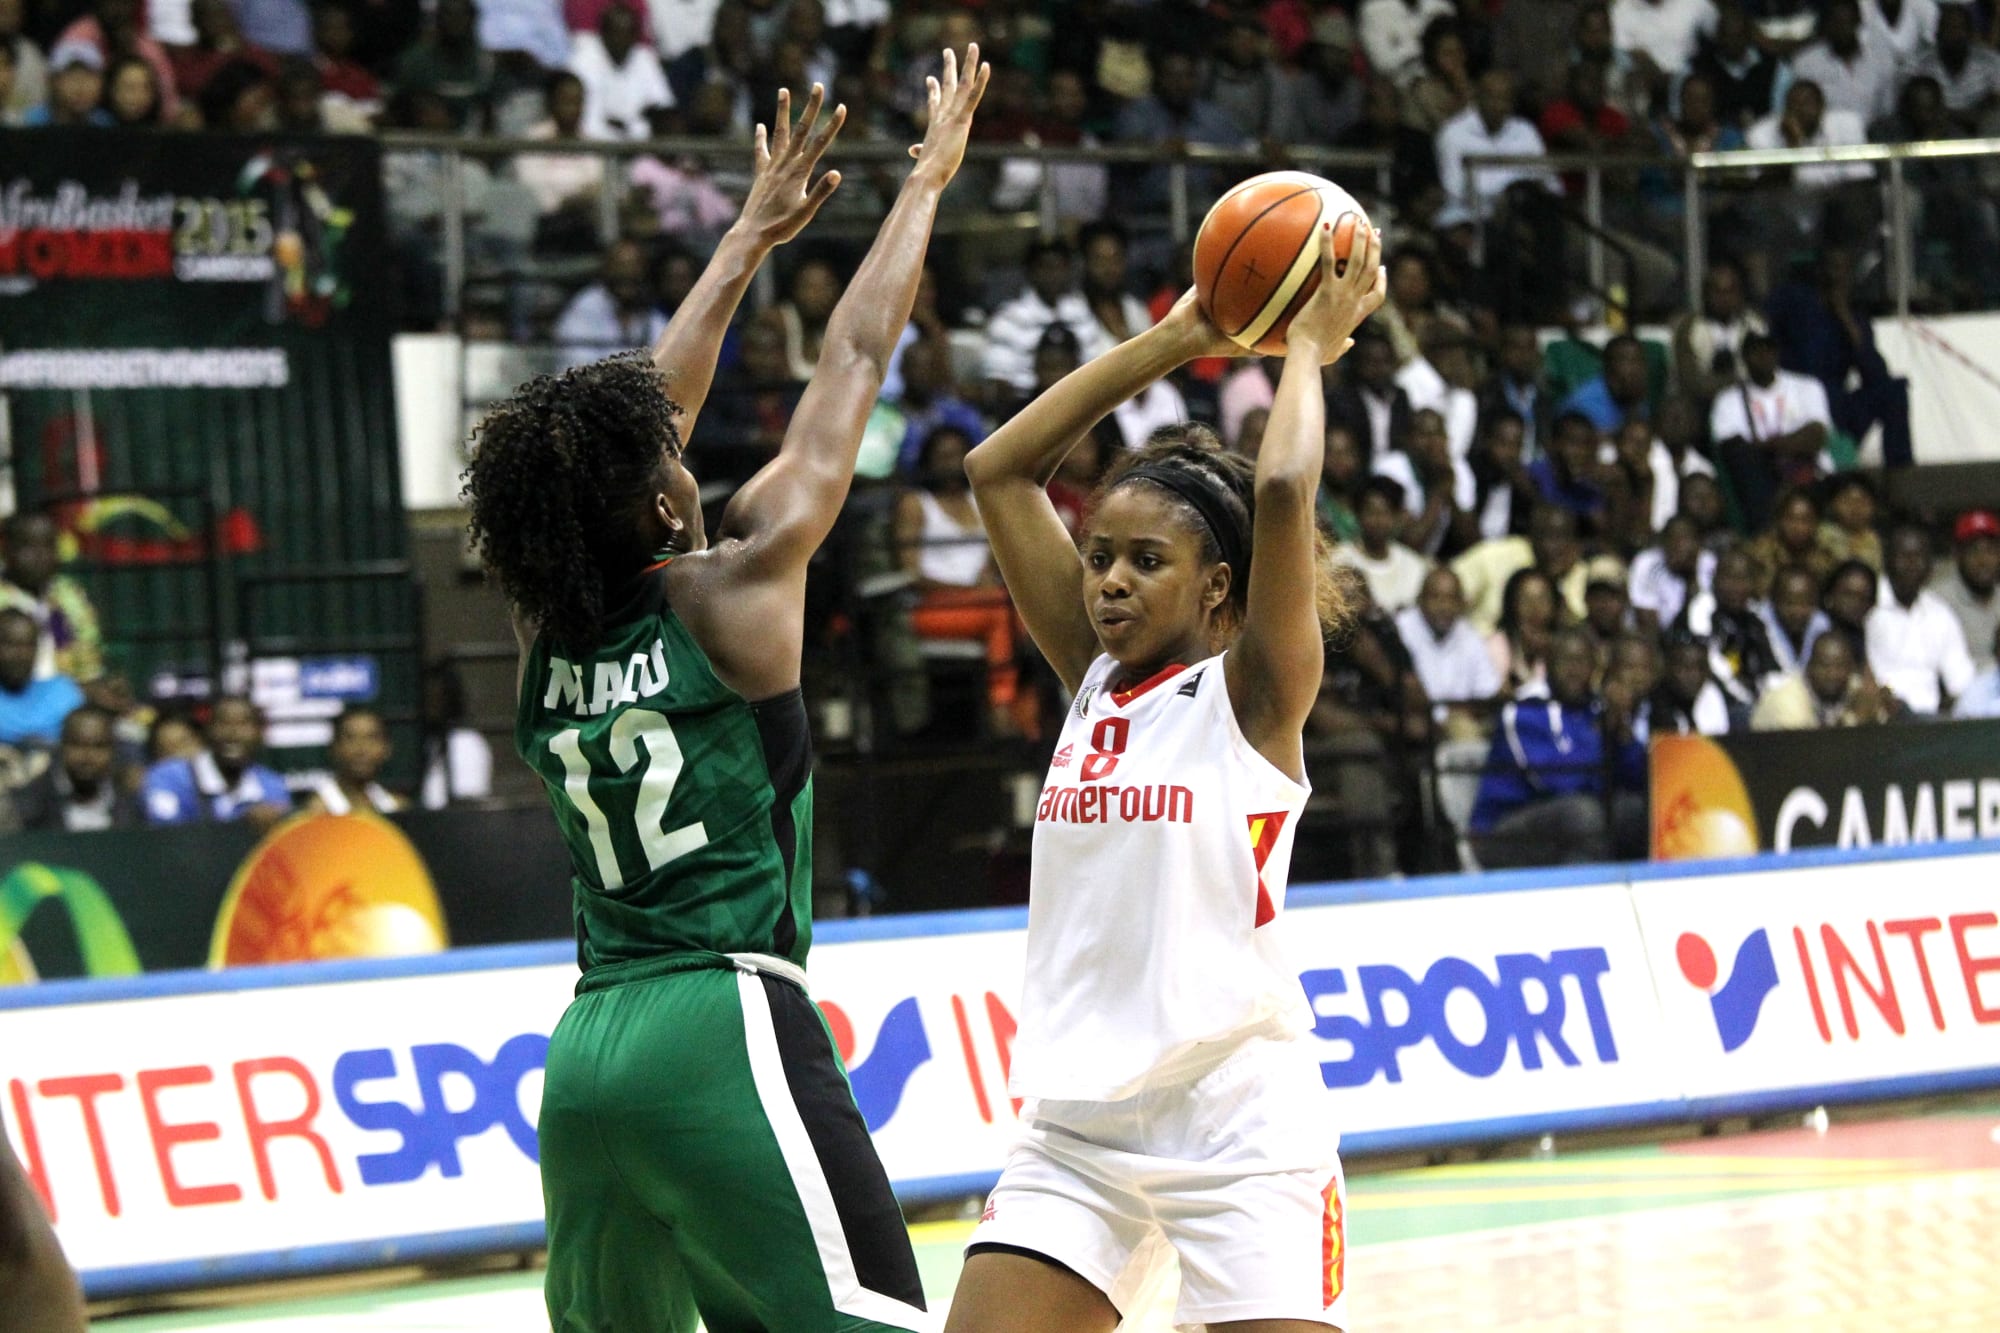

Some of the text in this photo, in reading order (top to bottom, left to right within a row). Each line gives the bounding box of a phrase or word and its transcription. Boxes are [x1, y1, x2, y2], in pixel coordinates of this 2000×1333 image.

[174, 197, 274, 256] 2015
[1079, 716, 1130, 782] 8
[549, 708, 709, 890] 12
[1037, 784, 1194, 824] ameroun
